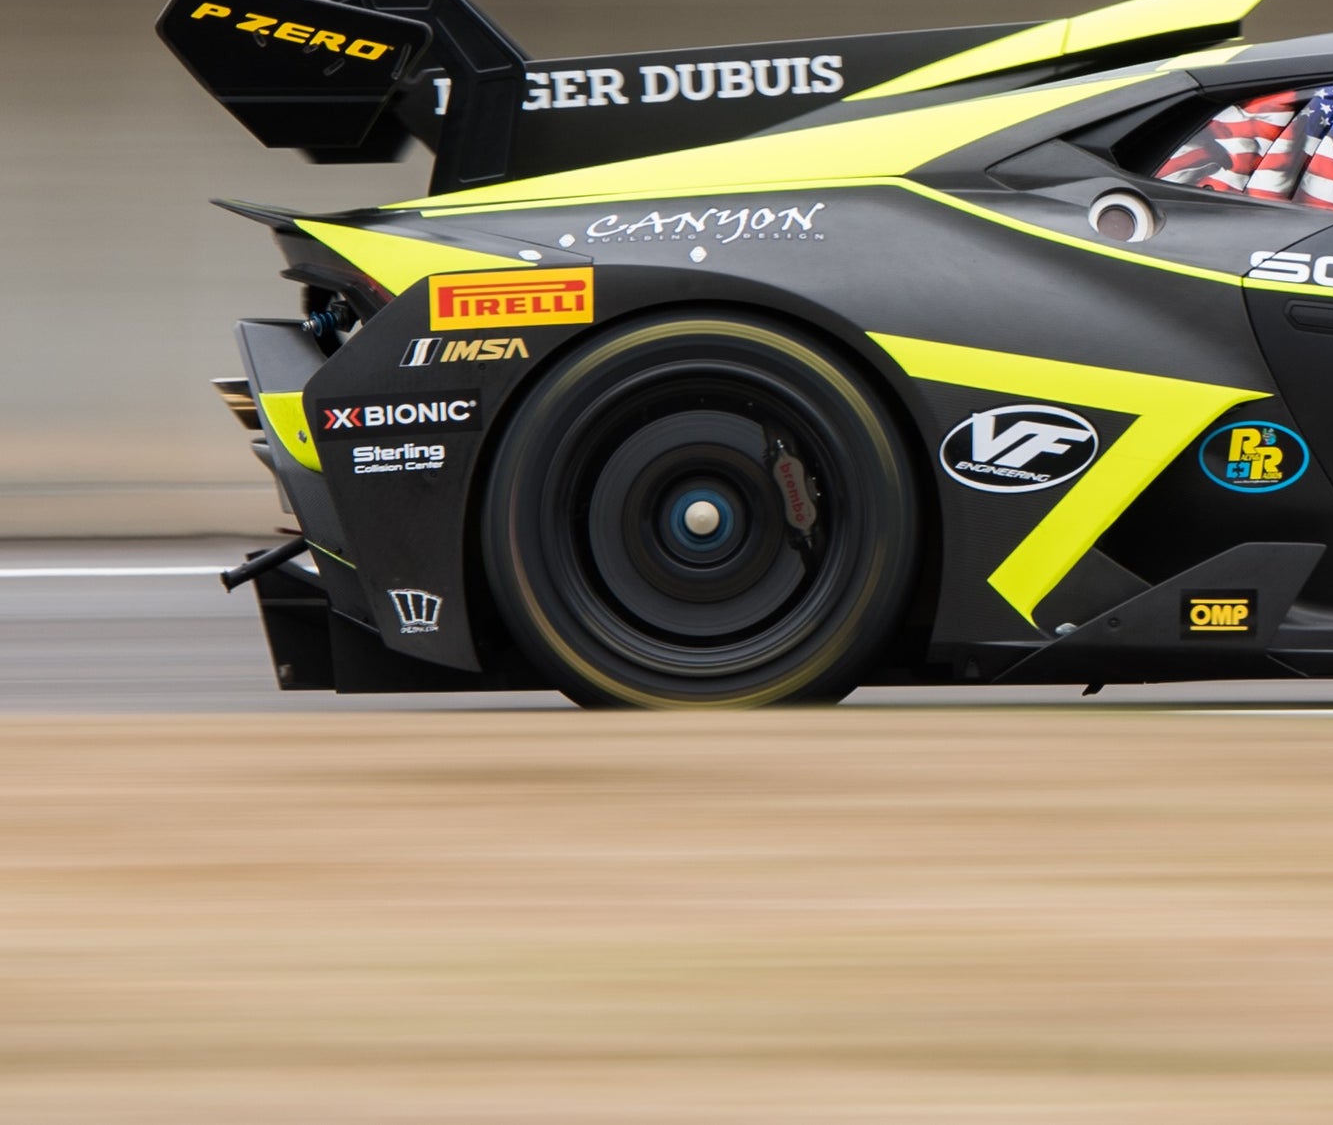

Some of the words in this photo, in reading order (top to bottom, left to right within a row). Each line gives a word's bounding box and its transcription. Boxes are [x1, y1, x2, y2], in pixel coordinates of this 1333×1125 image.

[191, 2, 231, 20] P
[236, 12, 388, 61] ZERO
[639, 55, 844, 104] DUBUIS
[586, 202, 825, 244] CANYON
[437, 279, 587, 318] PIRELLI
[440, 337, 530, 363] IMSA
[353, 443, 445, 463] Sterling
[354, 464, 403, 474] Collision
[405, 461, 444, 471] Center
[955, 461, 1051, 483] ENGINEERING
[778, 462, 805, 523] brembo
[1190, 604, 1249, 626] OMP
